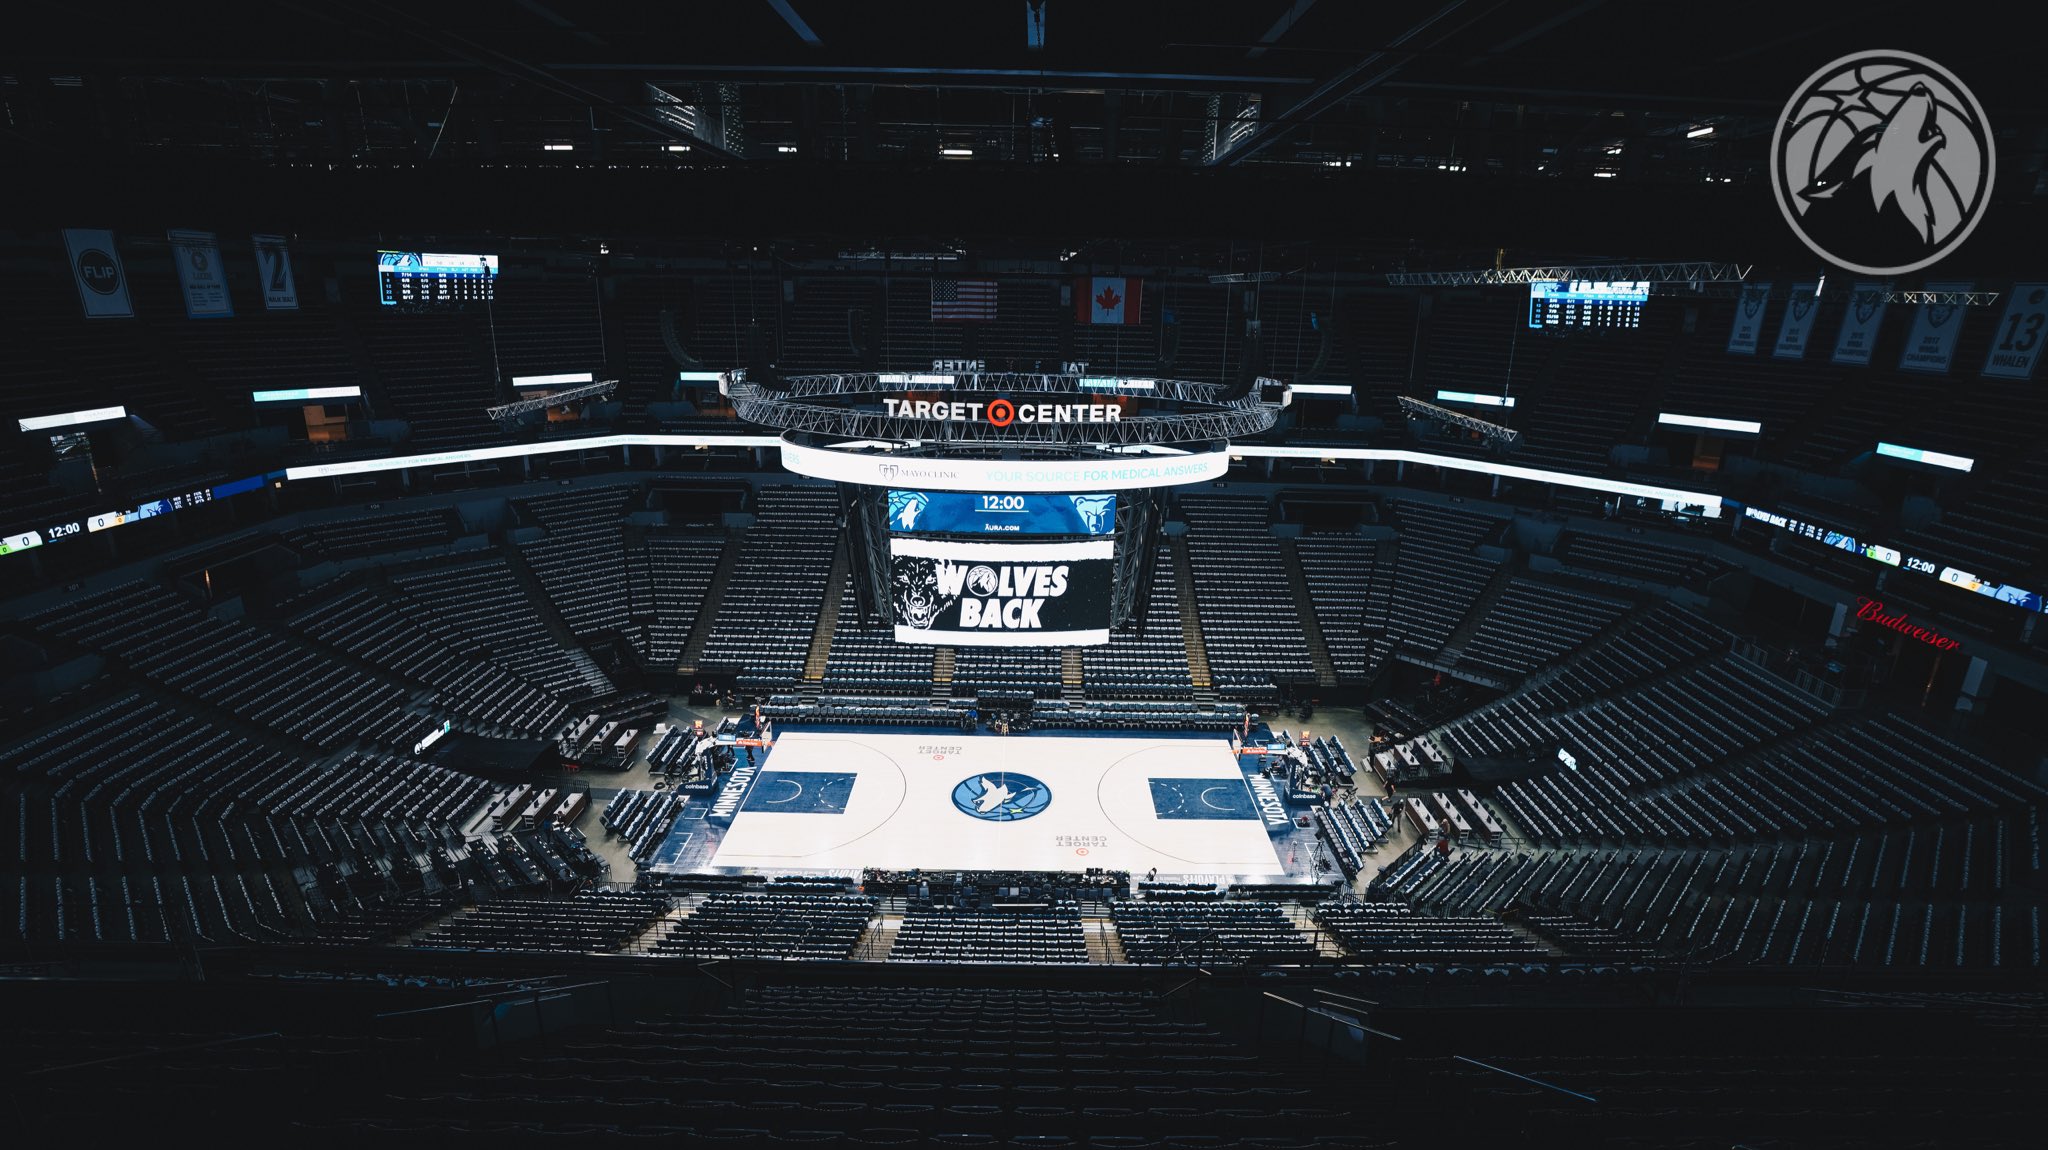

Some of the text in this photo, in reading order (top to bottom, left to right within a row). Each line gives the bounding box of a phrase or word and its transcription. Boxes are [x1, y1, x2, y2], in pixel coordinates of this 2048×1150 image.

[83, 266, 115, 279] FLIP
[258, 246, 287, 291] 2
[1999, 313, 2045, 351] 13
[1923, 336, 1941, 344] 2017
[1906, 354, 1947, 364] CHAMPIONS
[1993, 354, 2030, 368] WHALEN
[883, 398, 1121, 423] TARGET CENTER
[901, 468, 960, 479] MAYO CLINIC
[986, 462, 1208, 482] YOUR SOURCE FOR MEDICAL ANSWERS
[982, 495, 1025, 510] 12:00
[48, 522, 80, 538] 12:00
[98, 518, 104, 527] 0
[22, 537, 29, 546] 0
[1885, 552, 1891, 561] 0
[1907, 557, 1935, 574] 12:00
[1951, 573, 1958, 582] 0
[959, 598, 1045, 628] BACK
[1856, 595, 1960, 650] Budweiser
[708, 766, 758, 817] MINNESOTA
[1247, 774, 1290, 825] MINNESOTA
